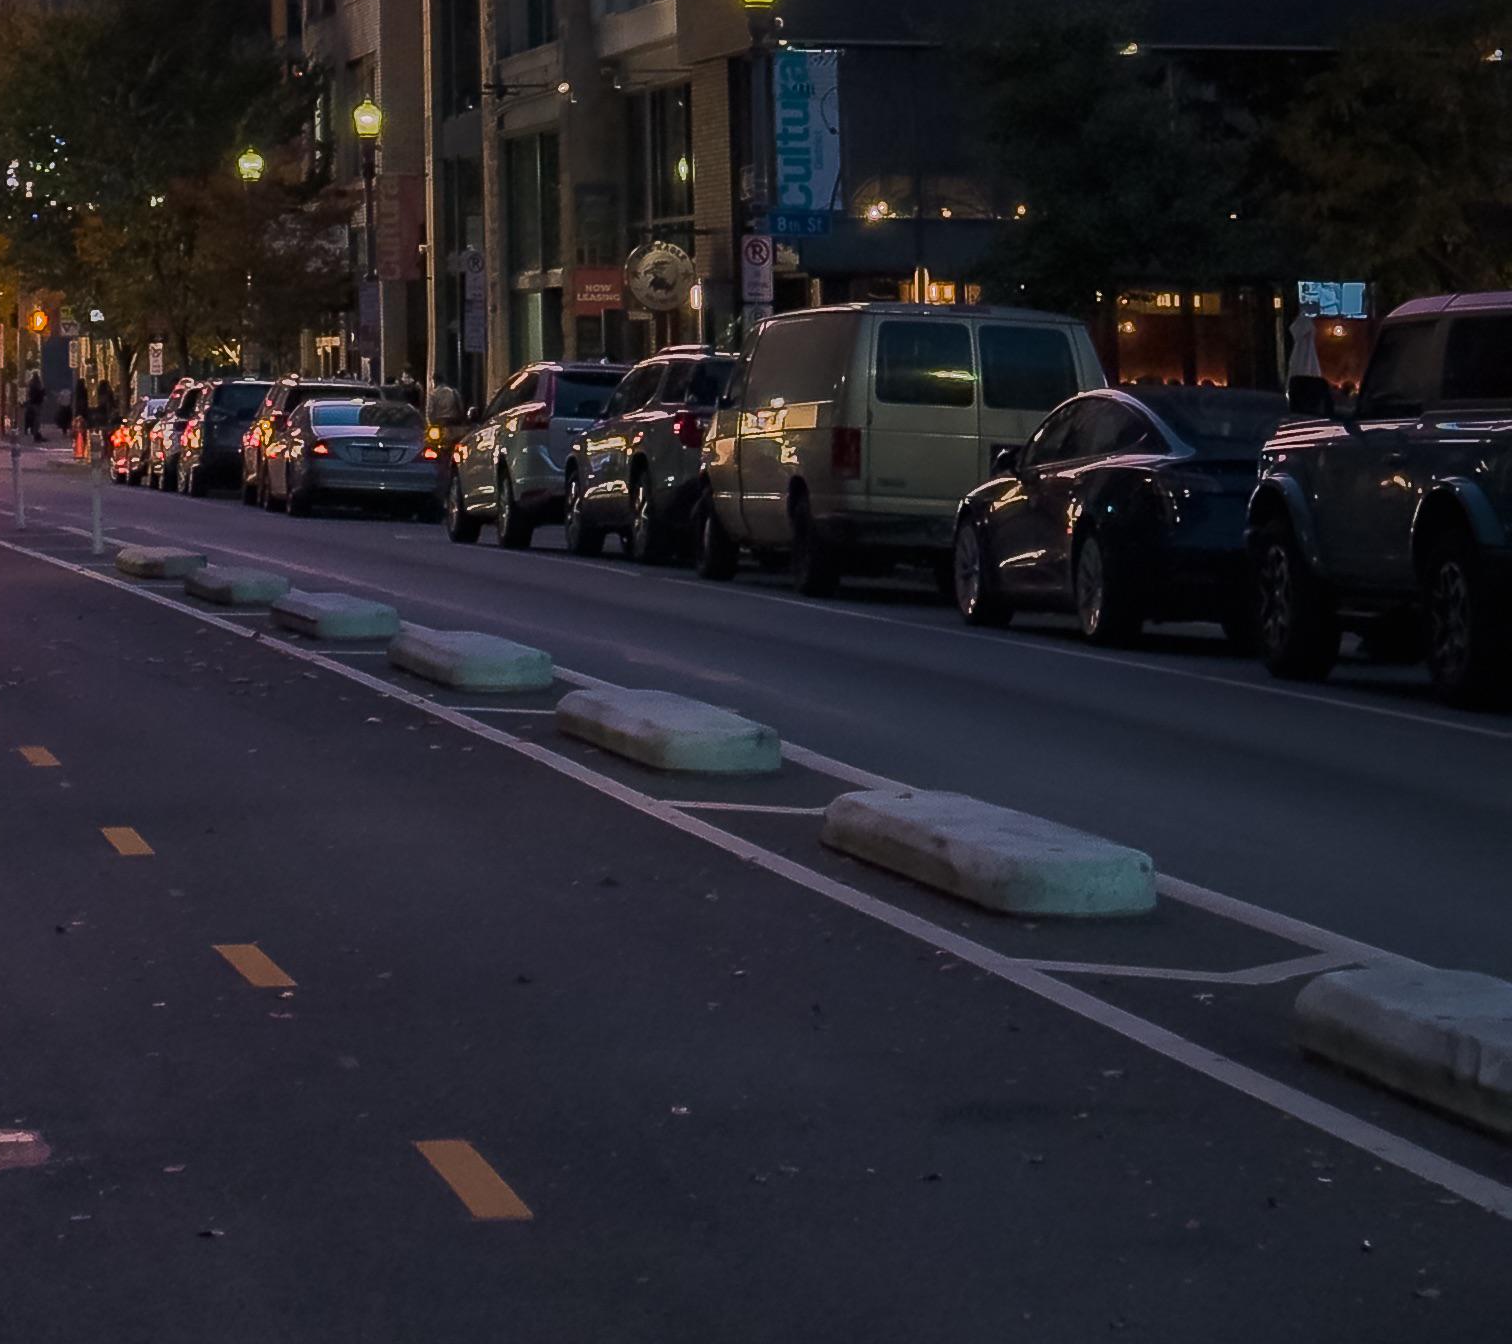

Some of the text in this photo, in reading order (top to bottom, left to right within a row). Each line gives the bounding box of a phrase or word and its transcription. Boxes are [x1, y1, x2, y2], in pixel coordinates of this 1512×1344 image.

[777, 216, 824, 233] 8th St
[585, 284, 612, 292] NOW
[576, 293, 621, 302] LEASING
